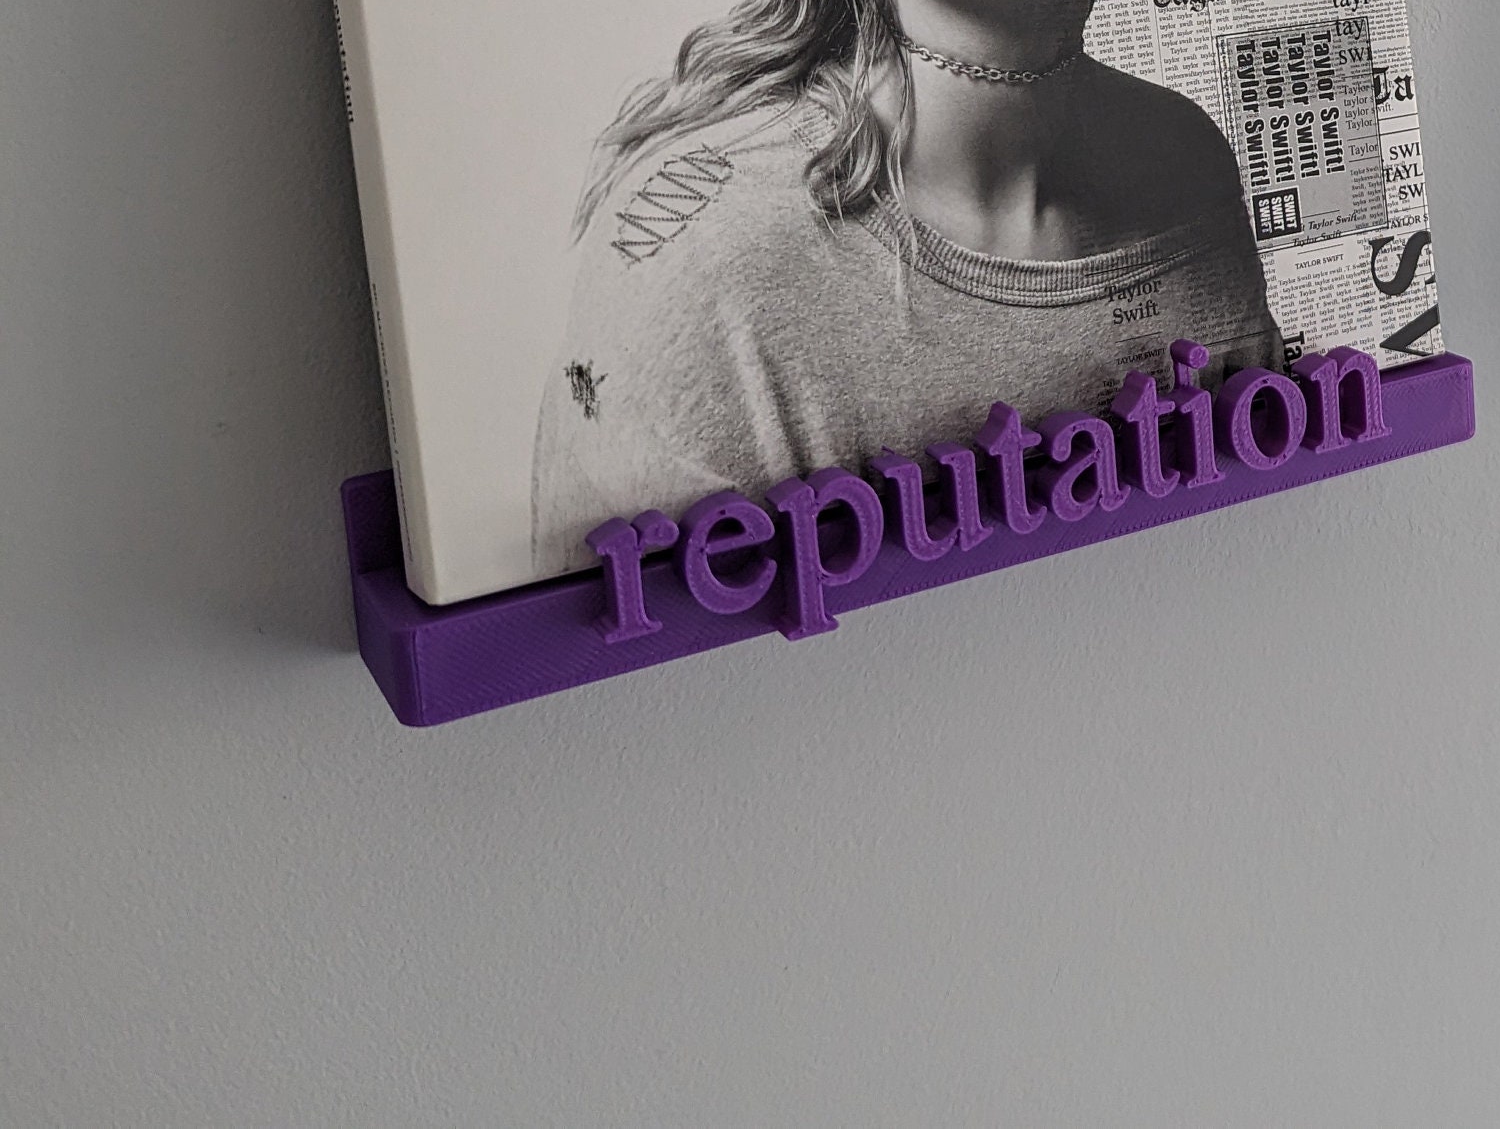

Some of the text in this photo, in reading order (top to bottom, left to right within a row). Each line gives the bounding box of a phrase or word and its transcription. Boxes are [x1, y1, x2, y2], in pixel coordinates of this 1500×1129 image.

[1236, 40, 1271, 187] Taylor Swift!
[1261, 36, 1296, 183] Taylor Swift!
[1287, 32, 1321, 178] Taylor Swift!
[1313, 30, 1345, 173] Taylor Swift!
[1343, 95, 1368, 107] taylor
[1345, 107, 1369, 118] taylor
[1258, 199, 1273, 234] SWIFT
[1271, 196, 1286, 231] SWIFT
[1283, 194, 1298, 229] SWIFT
[1309, 213, 1358, 230] Taylor Swift
[1295, 254, 1344, 270] TAYLOR SWIFT
[1106, 278, 1162, 303] Taylor
[1113, 300, 1160, 325] Swift
[586, 339, 1391, 642] reputation
